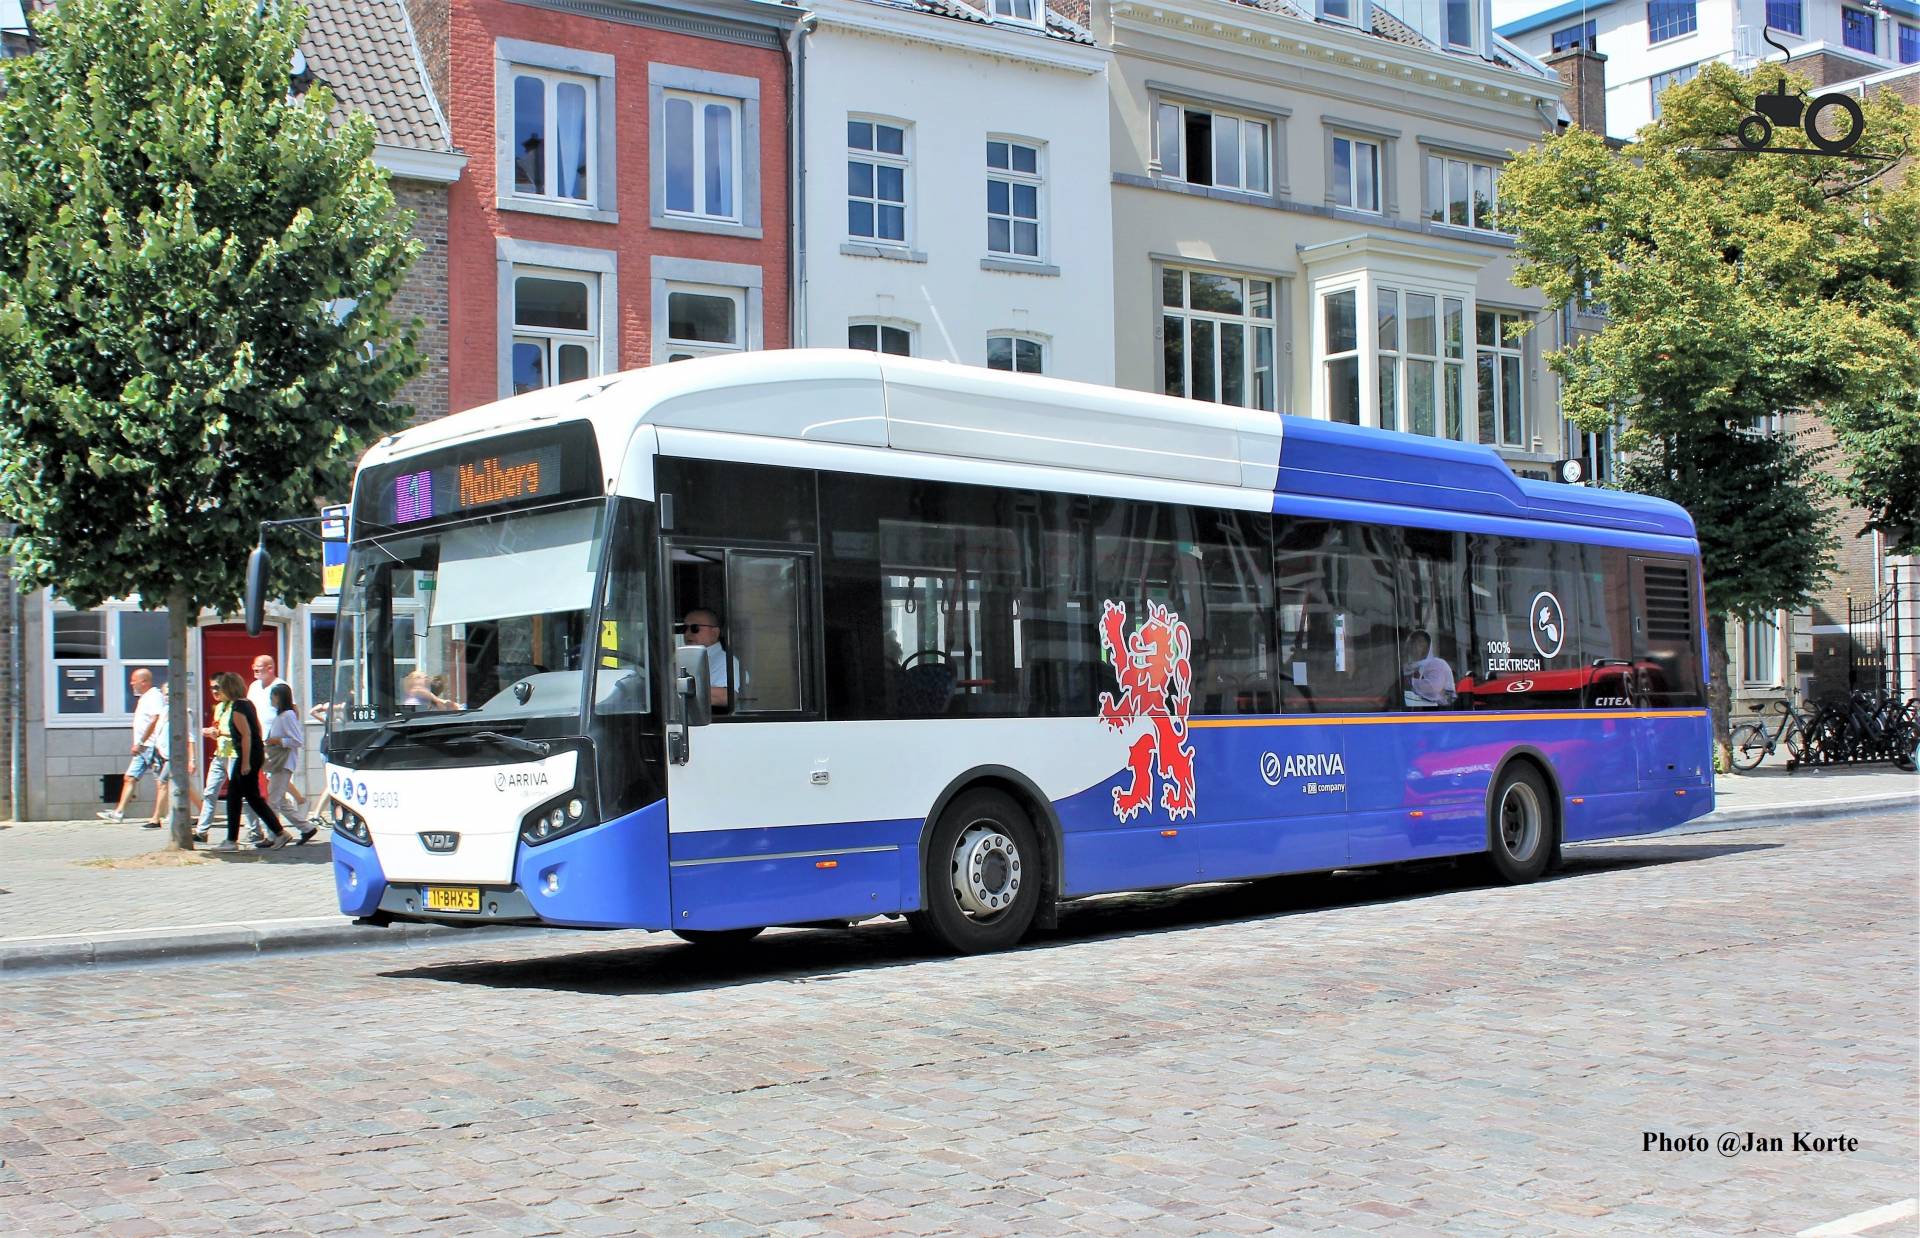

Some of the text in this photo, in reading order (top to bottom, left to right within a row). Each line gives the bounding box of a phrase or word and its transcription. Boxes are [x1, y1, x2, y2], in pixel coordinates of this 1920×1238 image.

[407, 457, 539, 516] 1 Malberg
[1487, 641, 1511, 654] 100%
[1488, 658, 1541, 671] ELEKTRISCH
[1595, 697, 1632, 706] CITEA
[352, 710, 376, 720] 1605
[1283, 753, 1345, 778] ARRIVA
[509, 772, 549, 787] ARRIVA
[1318, 783, 1345, 794] company
[372, 791, 399, 809] 9603
[423, 834, 455, 849] VDL
[432, 889, 474, 908] 11-BHX-5
